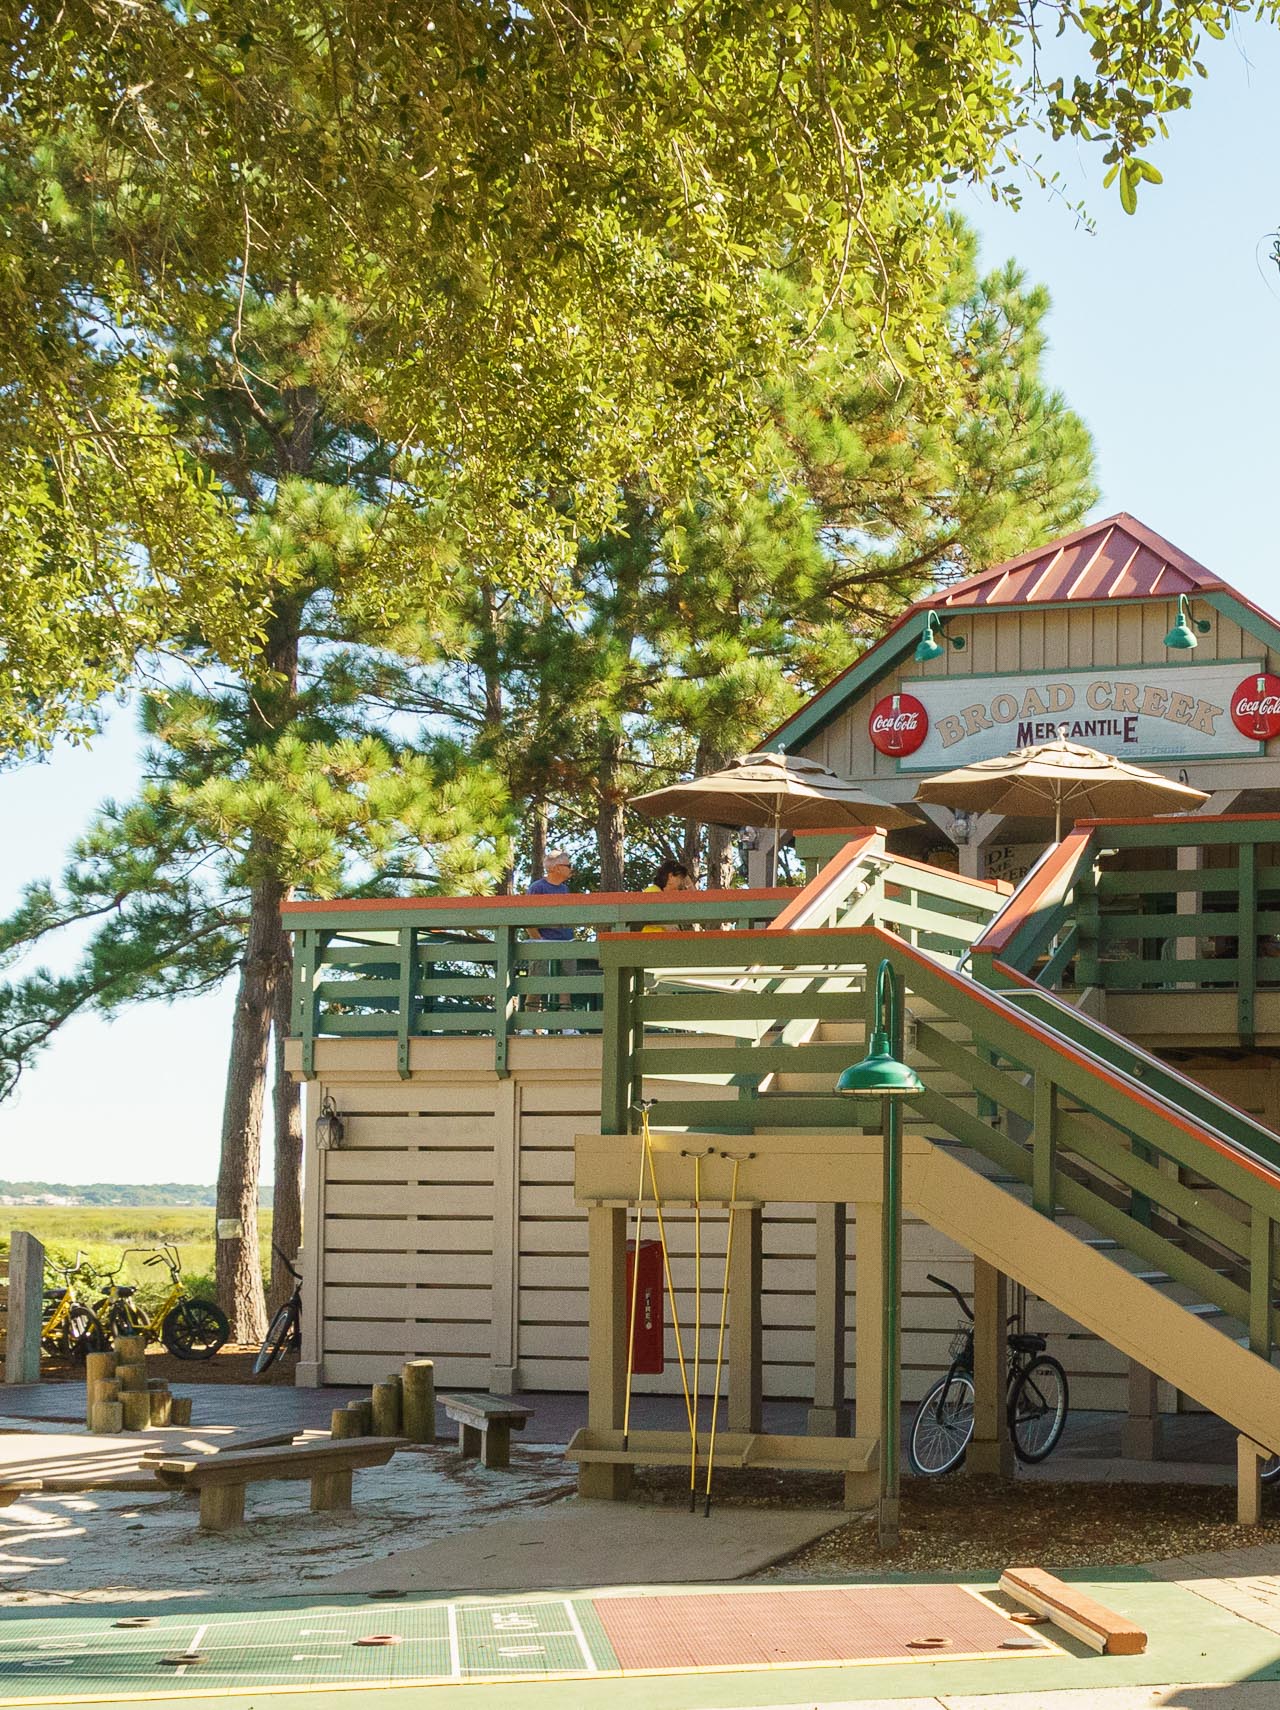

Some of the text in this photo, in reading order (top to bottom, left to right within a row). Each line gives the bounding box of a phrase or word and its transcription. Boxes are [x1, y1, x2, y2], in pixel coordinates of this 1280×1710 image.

[935, 681, 1224, 749] BROAD CREEK
[1016, 716, 1138, 748] MERCANTILE
